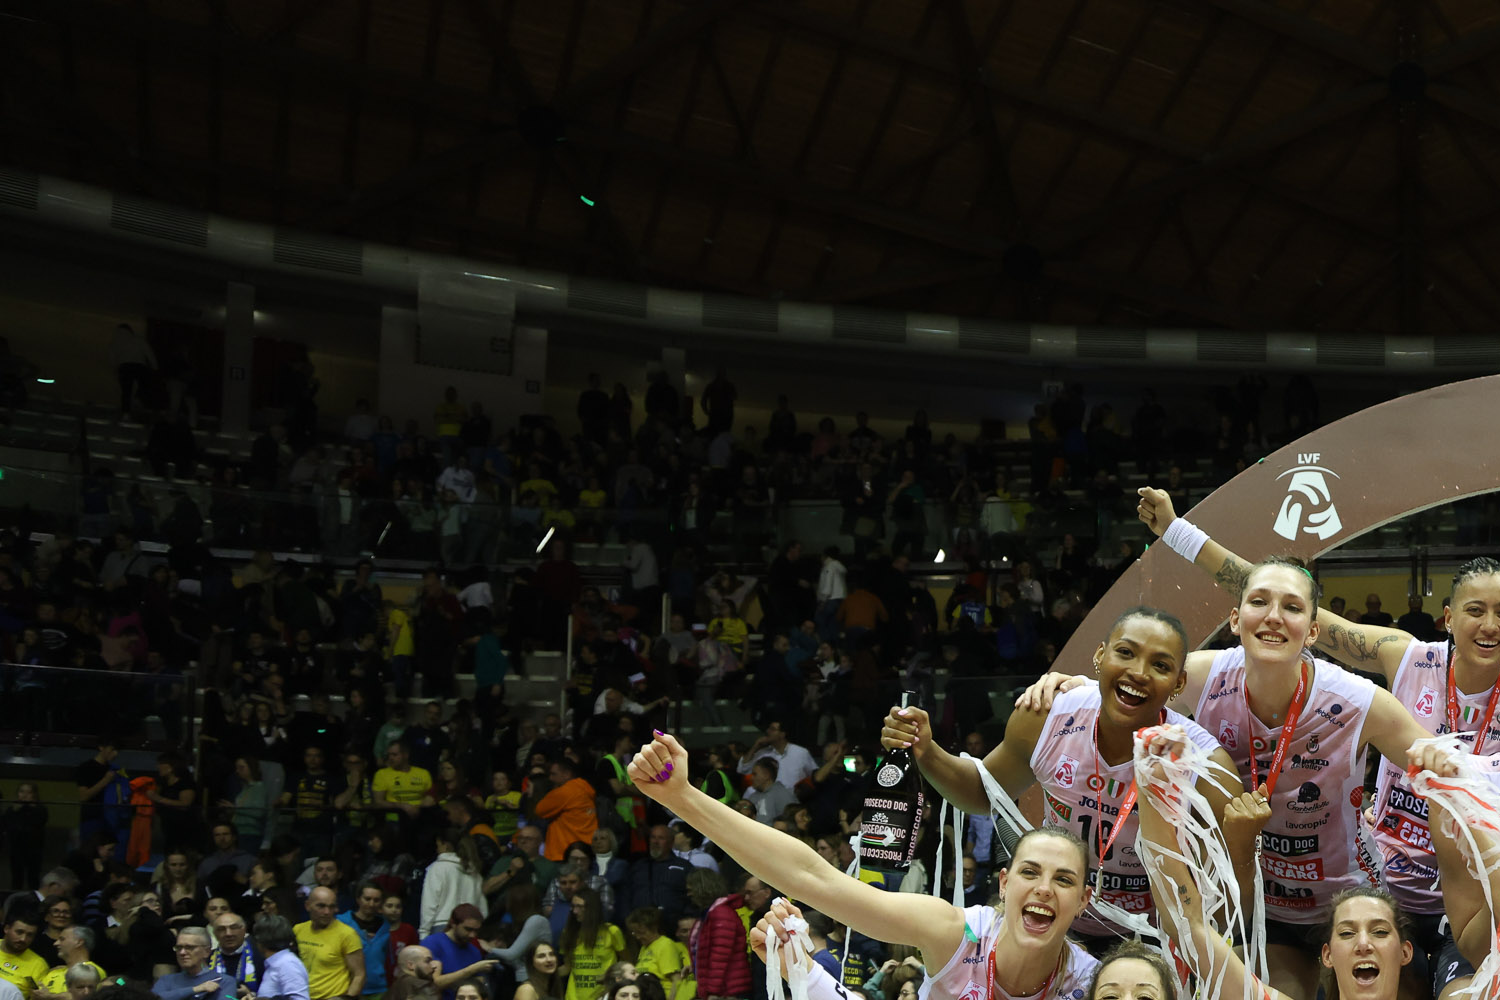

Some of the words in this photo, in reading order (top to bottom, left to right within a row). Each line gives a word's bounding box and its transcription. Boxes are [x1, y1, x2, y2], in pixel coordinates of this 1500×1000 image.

[1297, 453, 1321, 464] LVF
[893, 800, 908, 811] DOC
[1390, 789, 1429, 817] PROSE
[891, 827, 907, 839] DOC
[905, 809, 923, 864] PROSECCO
[1077, 814, 1114, 861] 16
[1294, 838, 1315, 849] DOC
[867, 848, 903, 861] PROSECCO
[1125, 877, 1147, 887] DOC
